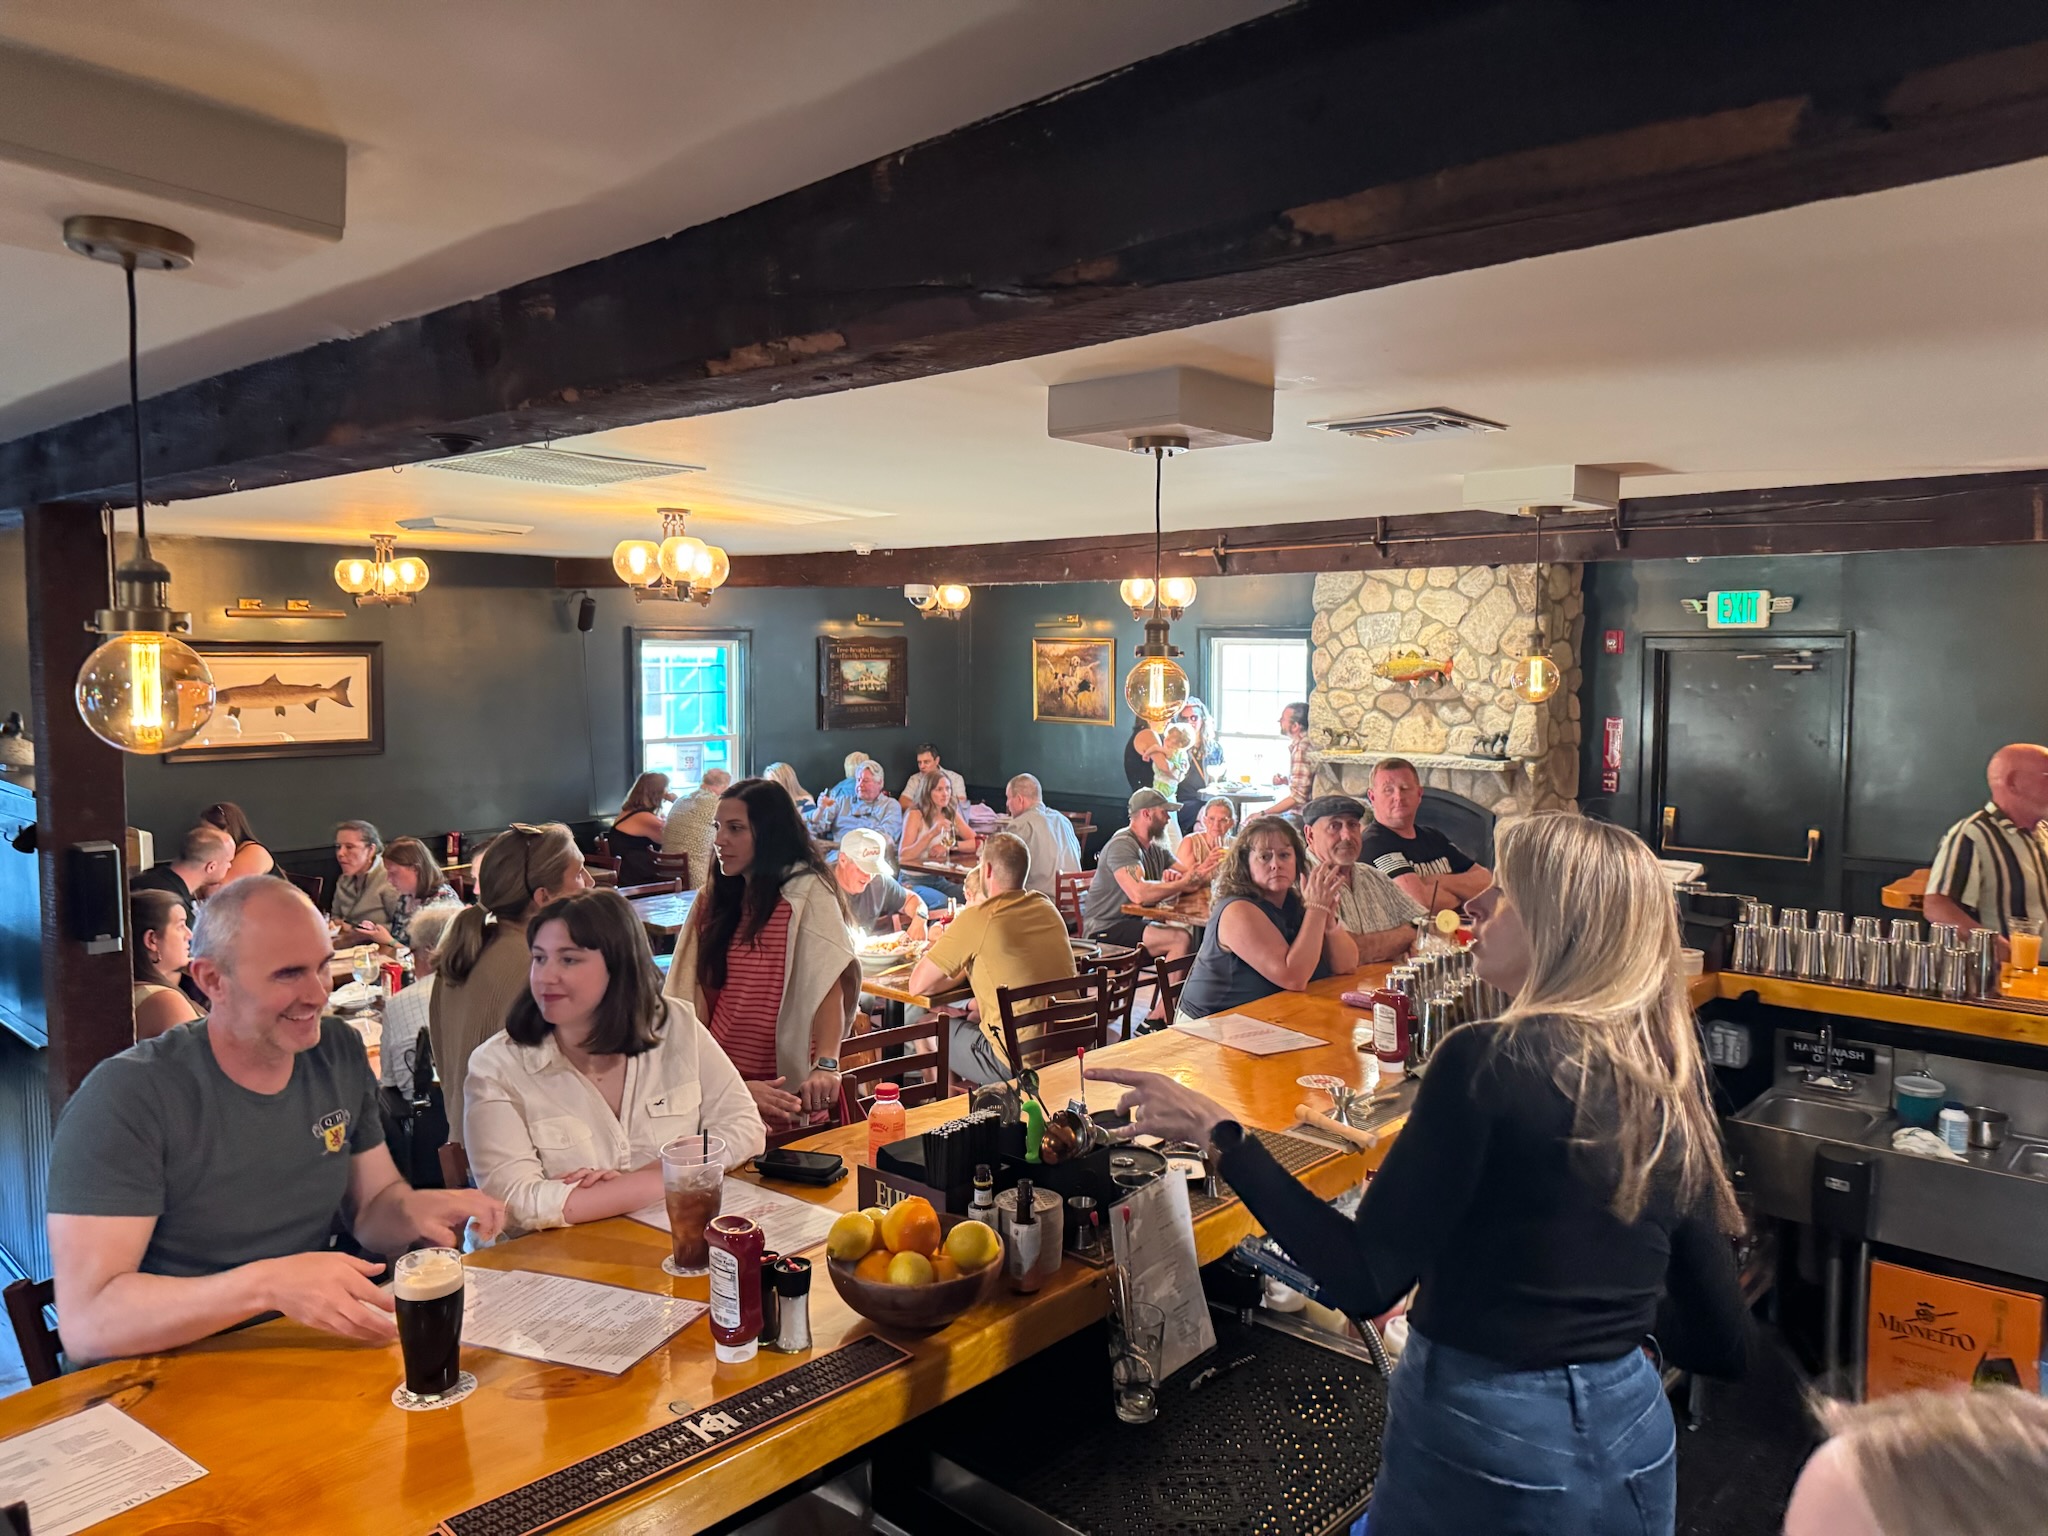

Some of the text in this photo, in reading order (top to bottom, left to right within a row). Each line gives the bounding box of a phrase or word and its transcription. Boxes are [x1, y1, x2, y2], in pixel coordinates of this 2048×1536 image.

[1718, 592, 1760, 624] EXIT
[1793, 1041, 1866, 1061] HAND WASH
[1812, 1053, 1844, 1066] OLY
[1877, 1312, 1976, 1352] MIONETTO
[735, 1384, 800, 1415] BASIL
[596, 1434, 689, 1479] HAYDEN
[109, 1468, 204, 1513] COCKTAILS
